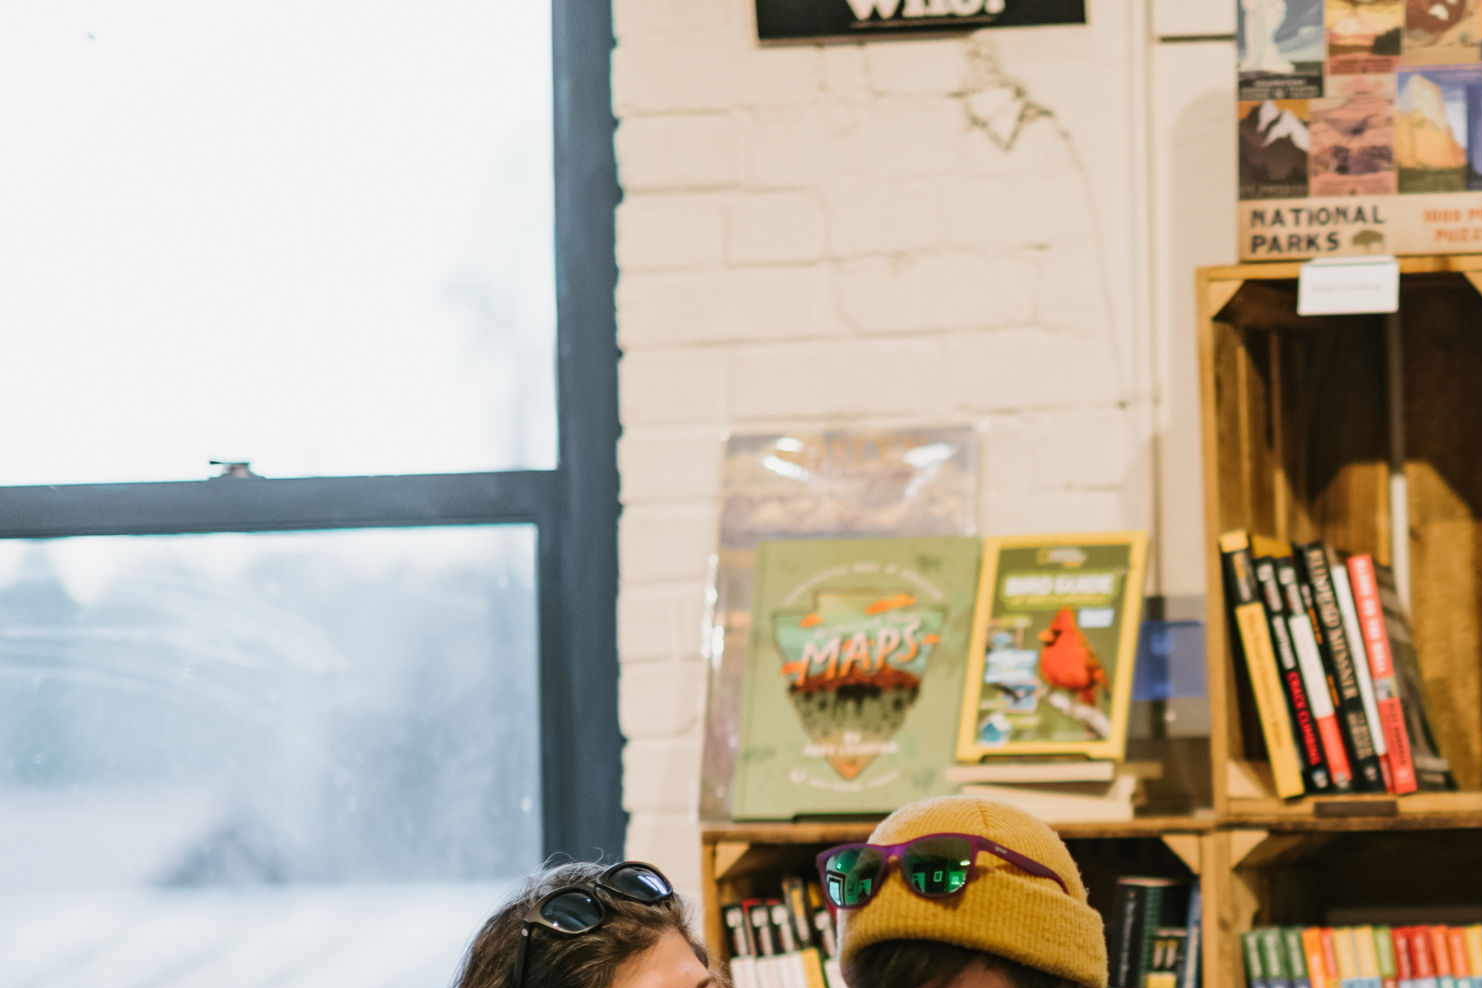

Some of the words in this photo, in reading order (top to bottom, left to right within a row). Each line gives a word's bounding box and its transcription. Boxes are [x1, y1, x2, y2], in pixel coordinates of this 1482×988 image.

[1251, 206, 1386, 227] NATIONAL
[1251, 232, 1340, 253] PARKS
[796, 620, 920, 686] MAPS
[1286, 670, 1306, 710] CRACK
[1296, 710, 1320, 766] CLIMBING
